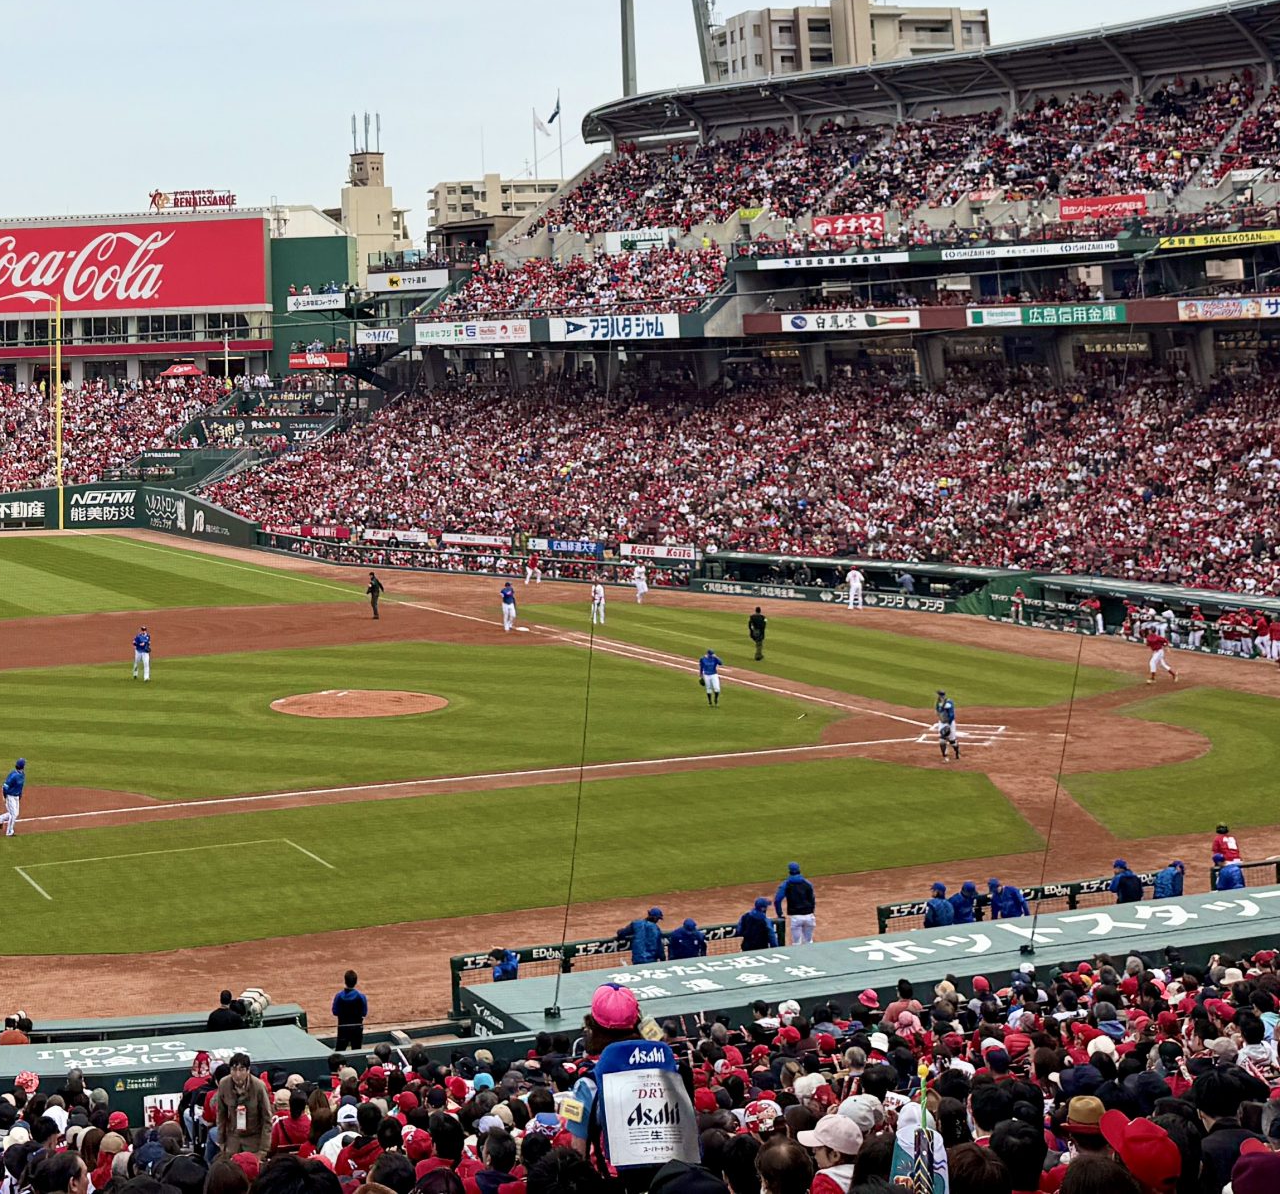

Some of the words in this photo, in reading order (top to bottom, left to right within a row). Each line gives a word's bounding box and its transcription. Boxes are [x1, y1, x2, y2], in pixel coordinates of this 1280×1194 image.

[174, 195, 237, 207] RENAISSANCE
[833, 215, 884, 235] チチヤス
[1203, 232, 1262, 244] SAKAEKOSAN
[401, 276, 427, 284] ヤマト運輸
[1029, 306, 1117, 323] 広島信用金庫
[589, 316, 664, 338] アヲハタジャム
[371, 330, 395, 342] MIG
[70, 489, 137, 505] NOHMI
[70, 506, 136, 521] 能美防災
[878, 594, 905, 607] フジタ
[920, 598, 945, 612] フジタ
[1080, 877, 1111, 893] エディ
[890, 902, 928, 918] エディオ
[849, 890, 1280, 964] ホットスタッ
[575, 938, 632, 957] エディオン
[608, 952, 791, 984] あなたに近い
[36, 1040, 187, 1060] ITの力で
[629, 1046, 666, 1065] Asahi
[637, 1088, 665, 1099] DRY
[627, 1102, 682, 1126] Asahi
[651, 1130, 663, 1140] 生
